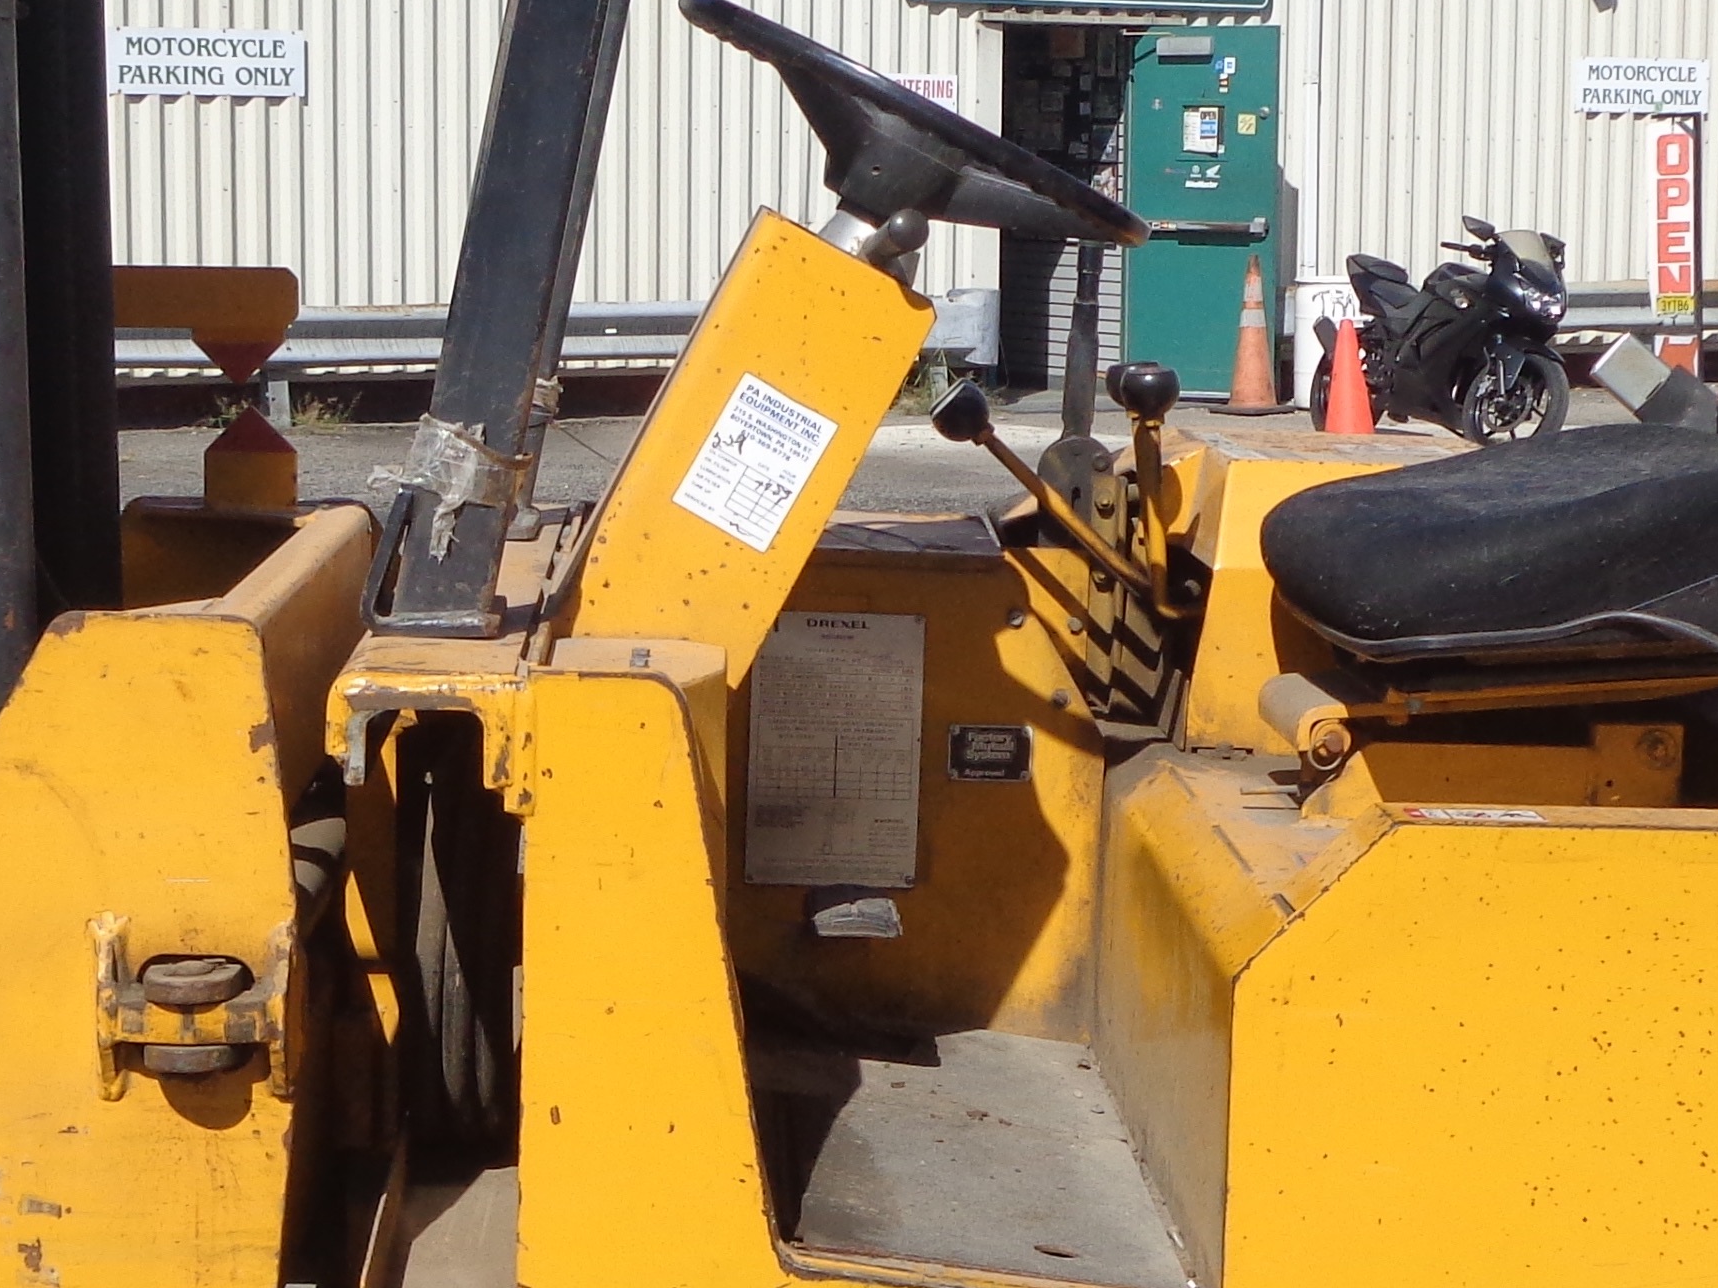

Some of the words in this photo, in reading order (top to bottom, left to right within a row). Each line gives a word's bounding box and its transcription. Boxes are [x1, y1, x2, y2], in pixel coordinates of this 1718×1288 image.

[125, 36, 286, 59] MOTORCYCLE
[118, 65, 224, 85] PARKING
[235, 67, 295, 86] ONLY
[1588, 65, 1697, 82] MOTORCYCLE
[1582, 88, 1654, 105] PARKING
[1661, 89, 1703, 106] ONLY
[1656, 133, 1692, 293] OPEN
[739, 392, 799, 430] EQUIPMENT
[746, 384, 760, 397] PA
[762, 394, 822, 433] INDUSTRIAL
[755, 419, 802, 448] WASHINGTON
[806, 618, 871, 630] DREXEL
